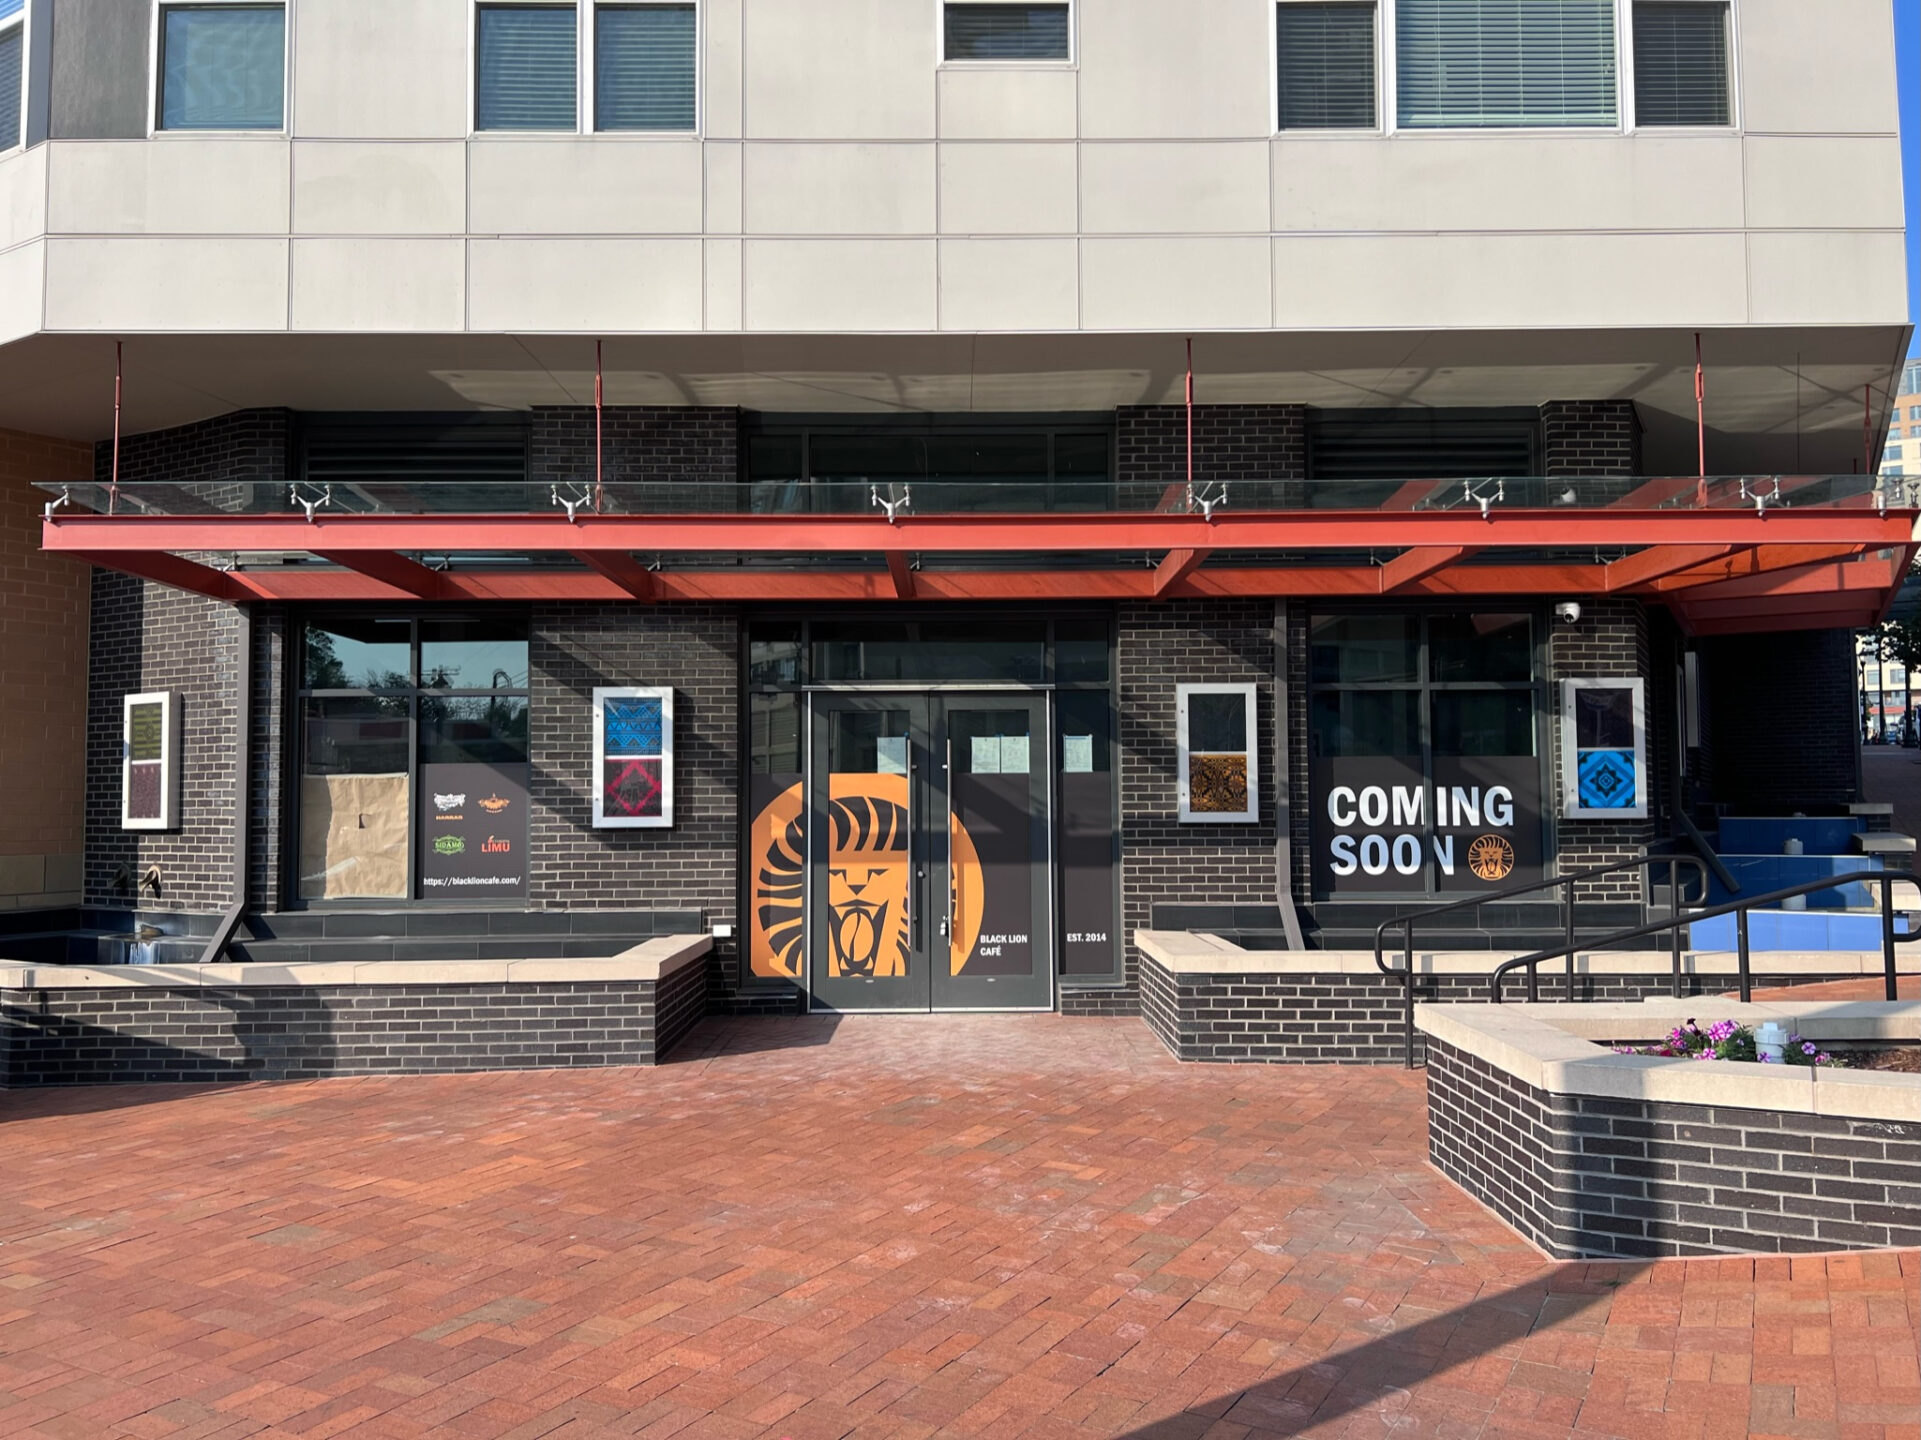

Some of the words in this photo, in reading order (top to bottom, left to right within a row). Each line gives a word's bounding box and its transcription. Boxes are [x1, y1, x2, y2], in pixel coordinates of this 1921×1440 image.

[1327, 785, 1514, 827] COMING
[481, 842, 511, 853] LIMU
[1329, 833, 1454, 876] SOON
[423, 876, 521, 887] https://blacklioncafe.com/
[980, 934, 1007, 943] BLACK
[1008, 934, 1028, 943] LION
[1066, 933, 1083, 942] EST.
[1085, 933, 1106, 942] 2014
[980, 945, 1001, 956] CAFÉ
